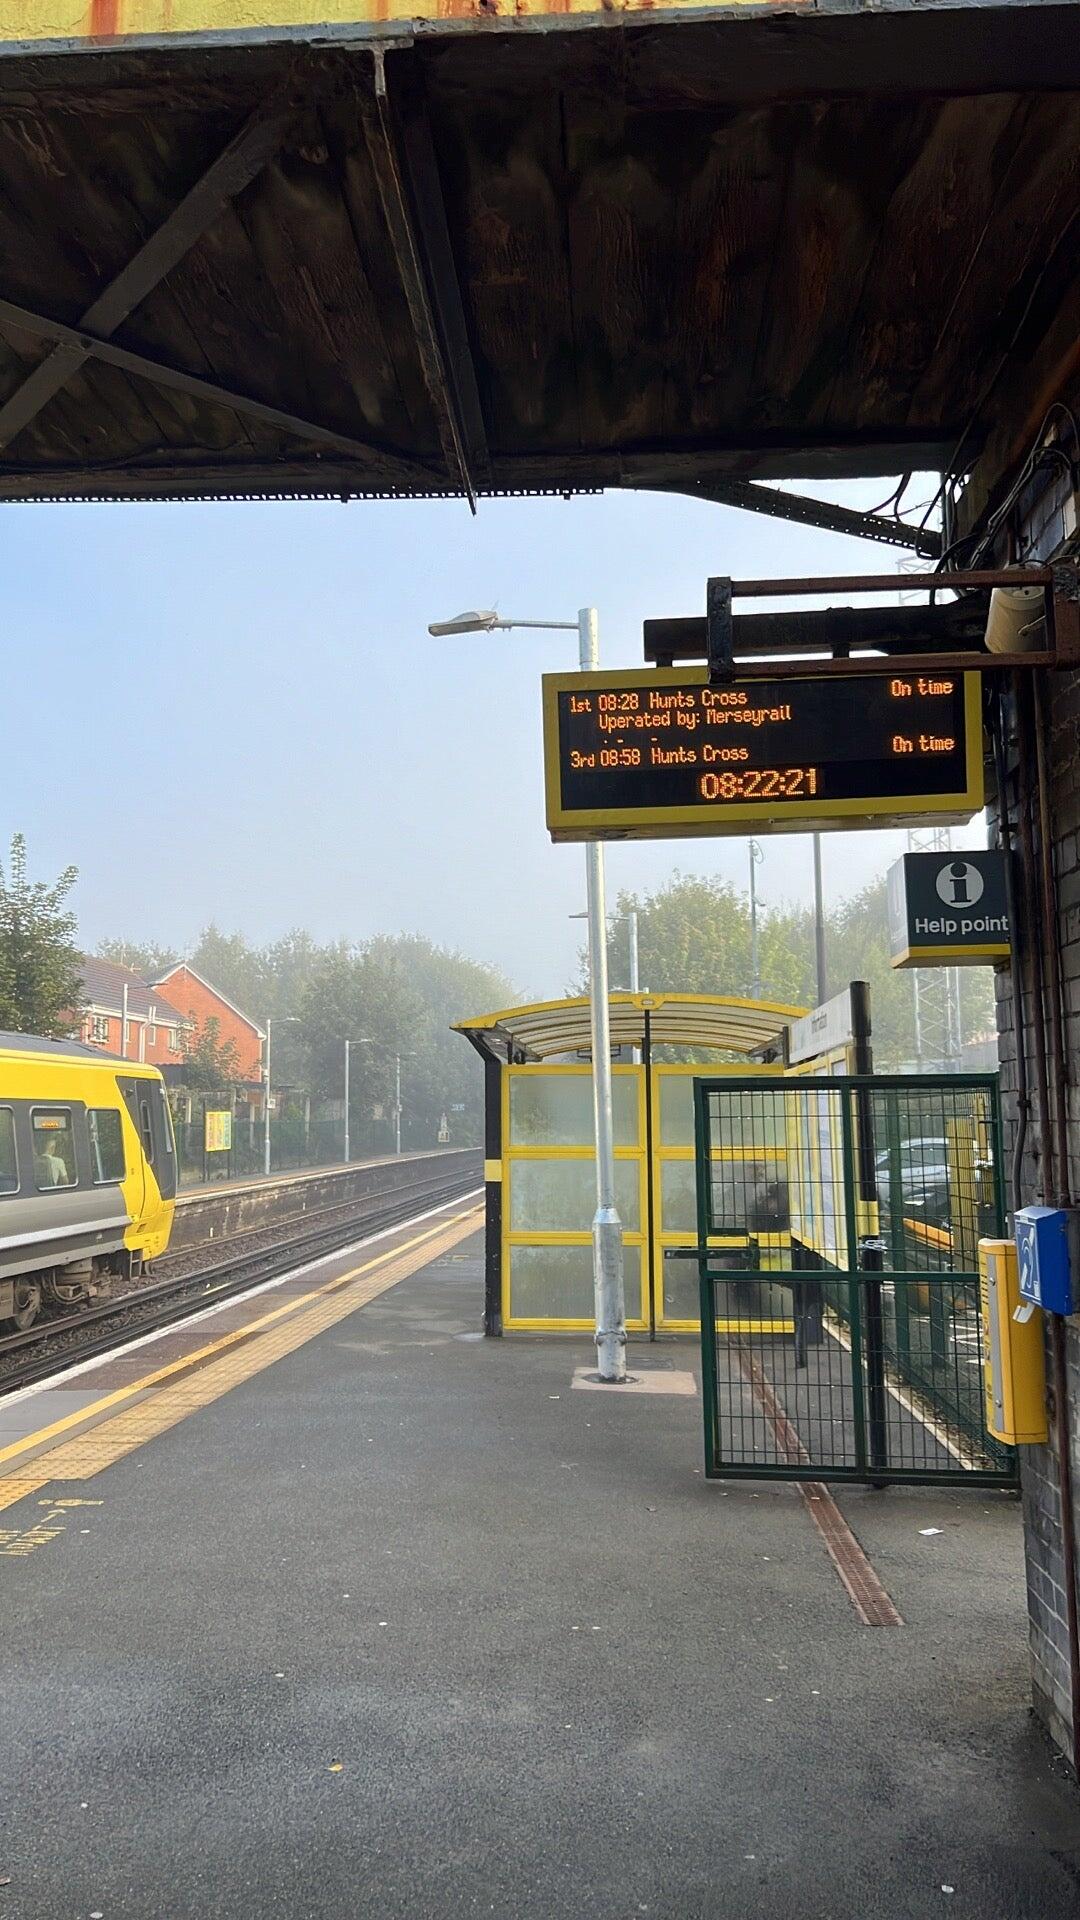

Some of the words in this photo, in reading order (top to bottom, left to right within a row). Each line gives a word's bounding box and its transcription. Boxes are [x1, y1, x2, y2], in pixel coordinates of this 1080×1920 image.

[571, 696, 592, 713] 1st
[598, 693, 640, 711] 08:28
[650, 691, 695, 709] Hunts
[702, 689, 748, 706] Cross
[891, 679, 911, 697] On
[918, 678, 954, 695] time
[677, 710, 700, 730] by:
[707, 705, 792, 726] Merseyrail
[571, 750, 595, 768] 3rd
[600, 748, 641, 766] 08:58
[651, 747, 697, 764] Hunts
[703, 744, 749, 761] Cross
[893, 735, 913, 753] On
[919, 734, 955, 751] time
[701, 768, 817, 799] 08:22:21
[915, 917, 957, 935] Help
[961, 915, 1009, 935] point
